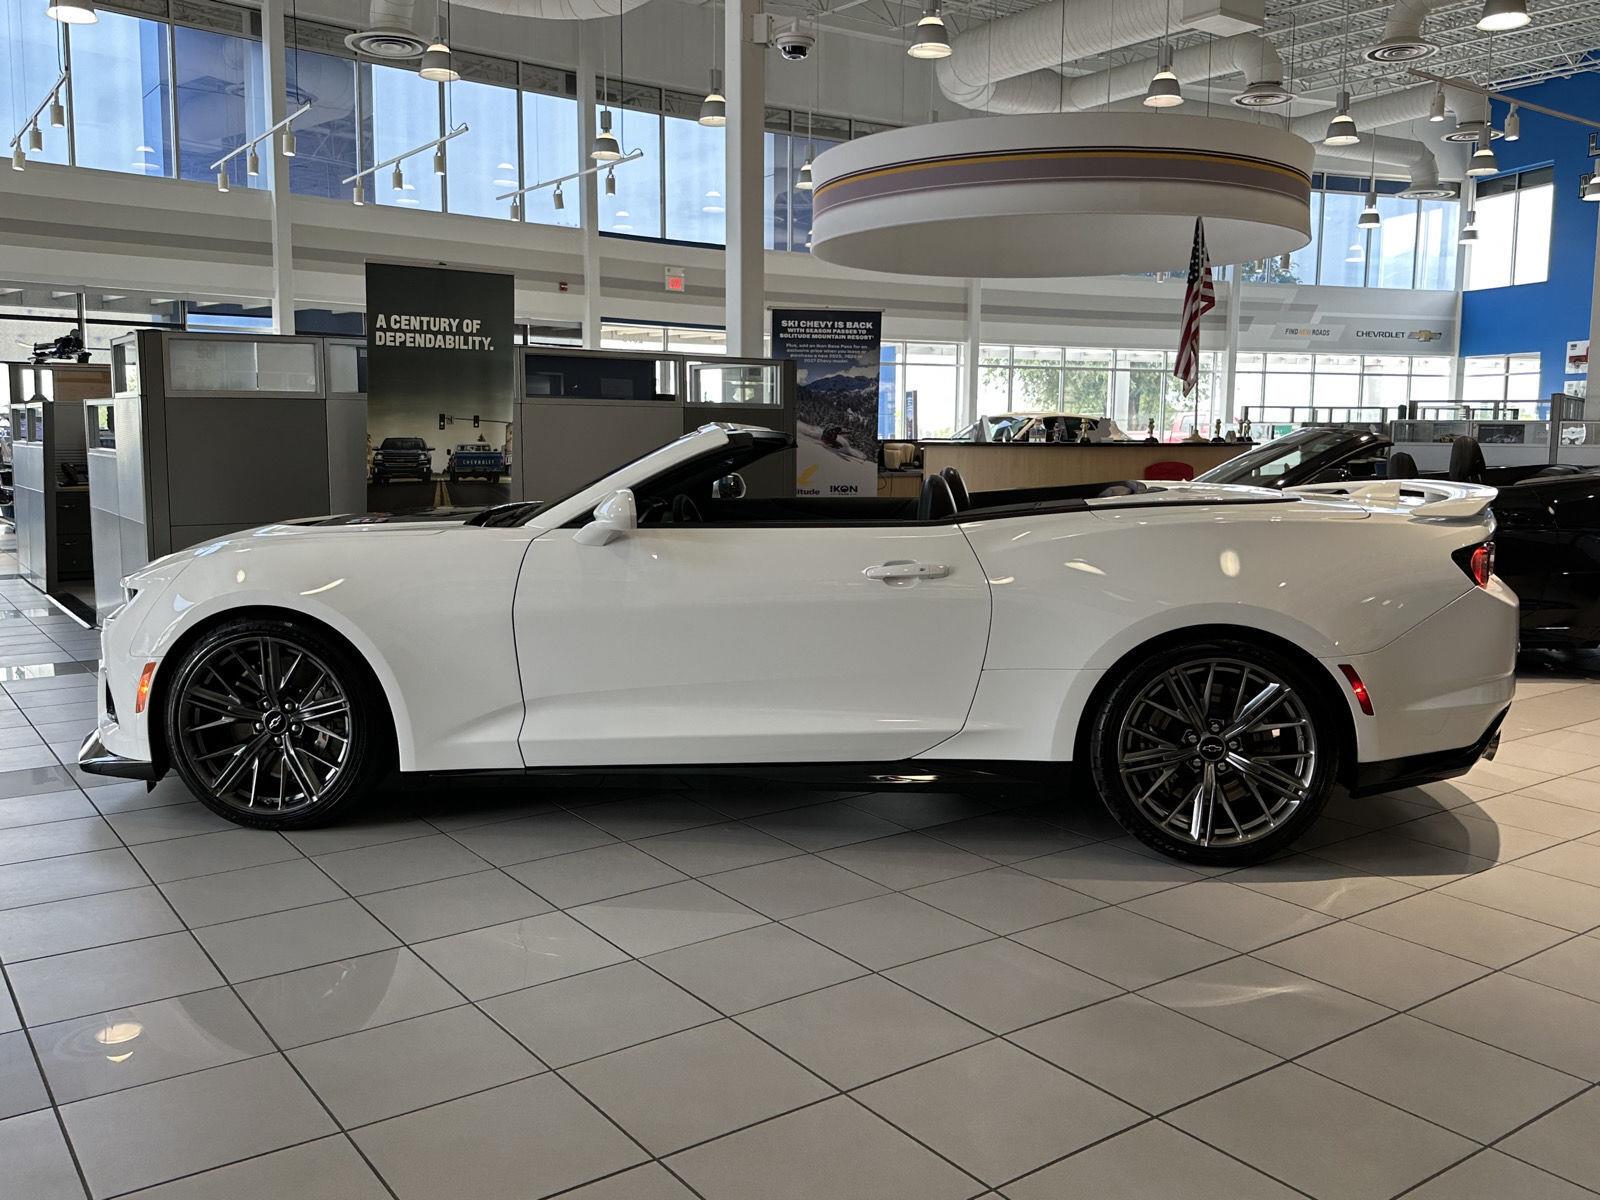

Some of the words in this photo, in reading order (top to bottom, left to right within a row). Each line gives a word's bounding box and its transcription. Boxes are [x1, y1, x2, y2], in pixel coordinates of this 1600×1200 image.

[376, 314, 387, 329] A
[390, 314, 460, 332] CENTURY
[462, 319, 481, 334] OF
[781, 320, 798, 328] SKI
[800, 320, 833, 328] CHEVY
[834, 321, 845, 329] IS
[846, 321, 873, 329] BACK
[1356, 330, 1405, 339] CHEVROLET
[375, 331, 494, 351] DEPENDABILITY.
[830, 485, 858, 493] IKON
